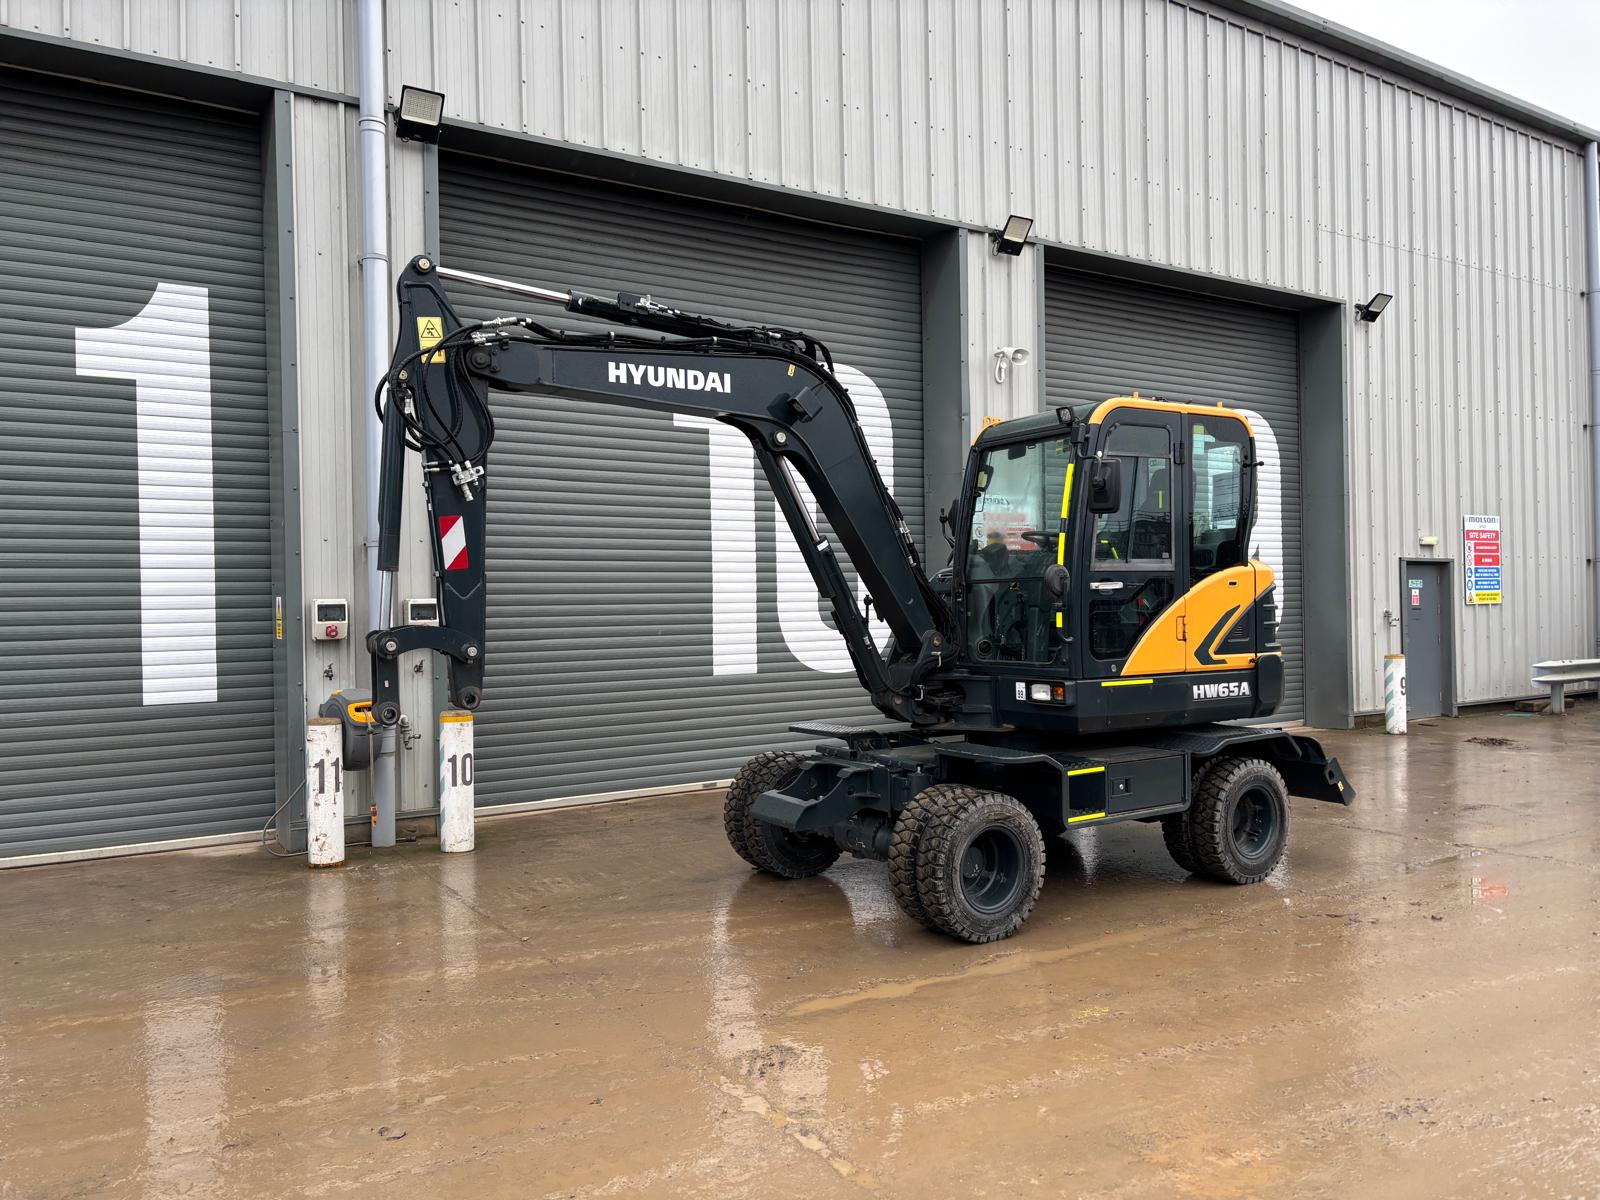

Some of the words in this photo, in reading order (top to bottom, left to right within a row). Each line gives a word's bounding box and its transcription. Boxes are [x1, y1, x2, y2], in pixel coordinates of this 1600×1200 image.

[608, 361, 731, 394] HYUNDAI
[1479, 532, 1496, 540] SAFETY
[1192, 681, 1251, 700] HW65A
[1400, 676, 1407, 695] 9
[312, 757, 340, 794] 11
[447, 752, 473, 788] 10
